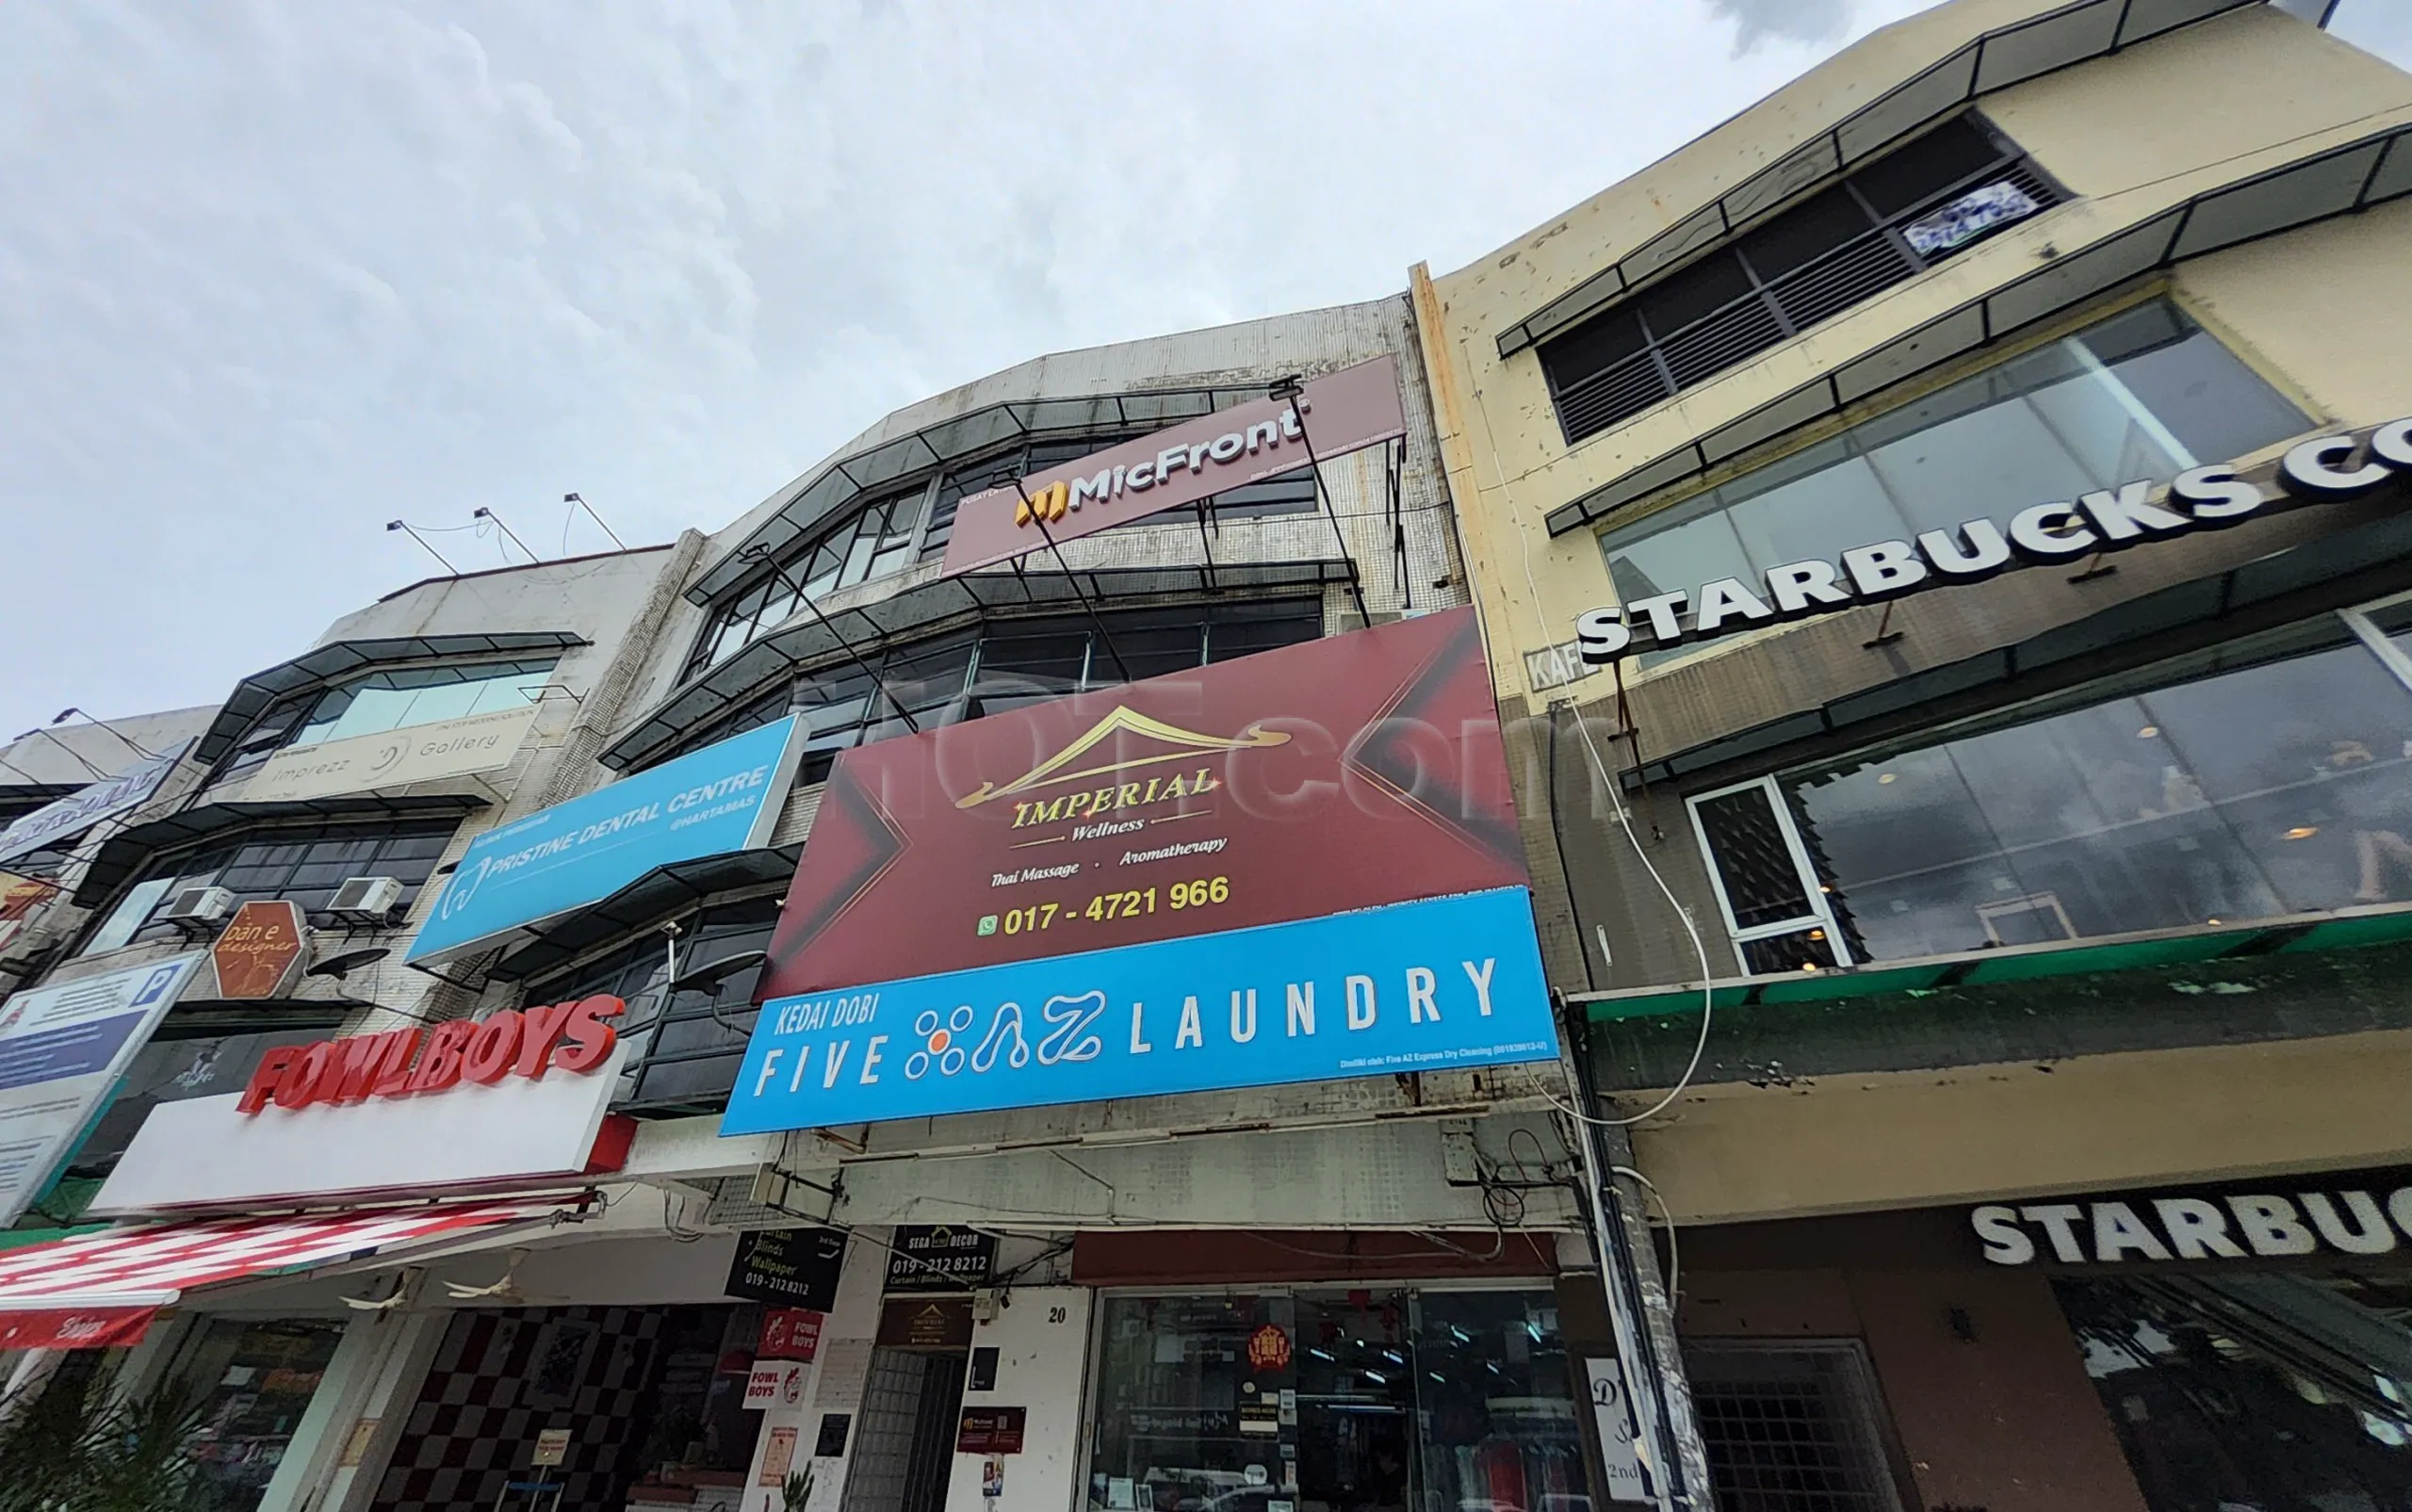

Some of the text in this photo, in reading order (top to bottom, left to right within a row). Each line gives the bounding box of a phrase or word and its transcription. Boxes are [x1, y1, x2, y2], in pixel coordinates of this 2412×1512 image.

[1068, 406, 1304, 511] MicFront
[1576, 464, 2263, 661] STARBUCKS
[1010, 767, 1217, 830] IMPERIAL
[486, 830, 578, 880] PRISTINE
[577, 802, 660, 846] DENTAL
[667, 764, 769, 814] CENTRE
[669, 795, 757, 832] @HARTAMAS
[1072, 817, 1145, 841] Wellness
[991, 837, 1229, 887] Thai Massage Aromatherapy
[1003, 902, 1059, 935] 017
[1085, 887, 1156, 922] 4721
[1169, 876, 1229, 910] 966
[773, 993, 880, 1036] KEDAI DOBI
[754, 1034, 889, 1097] FIVE
[1130, 957, 1496, 1054] LAUNDRY
[950, 1233, 979, 1247] DECOR
[750, 1255, 798, 1276] Wallpaper
[892, 1260, 918, 1274] 019
[953, 1256, 986, 1272] 8212
[1048, 1306, 1067, 1325] 20
[791, 1334, 816, 1348] BOYS
[794, 1322, 818, 1336] FOWL
[751, 1372, 778, 1383] FOWL
[748, 1386, 775, 1397] BOYS
[1608, 1462, 1639, 1479] 2nd
